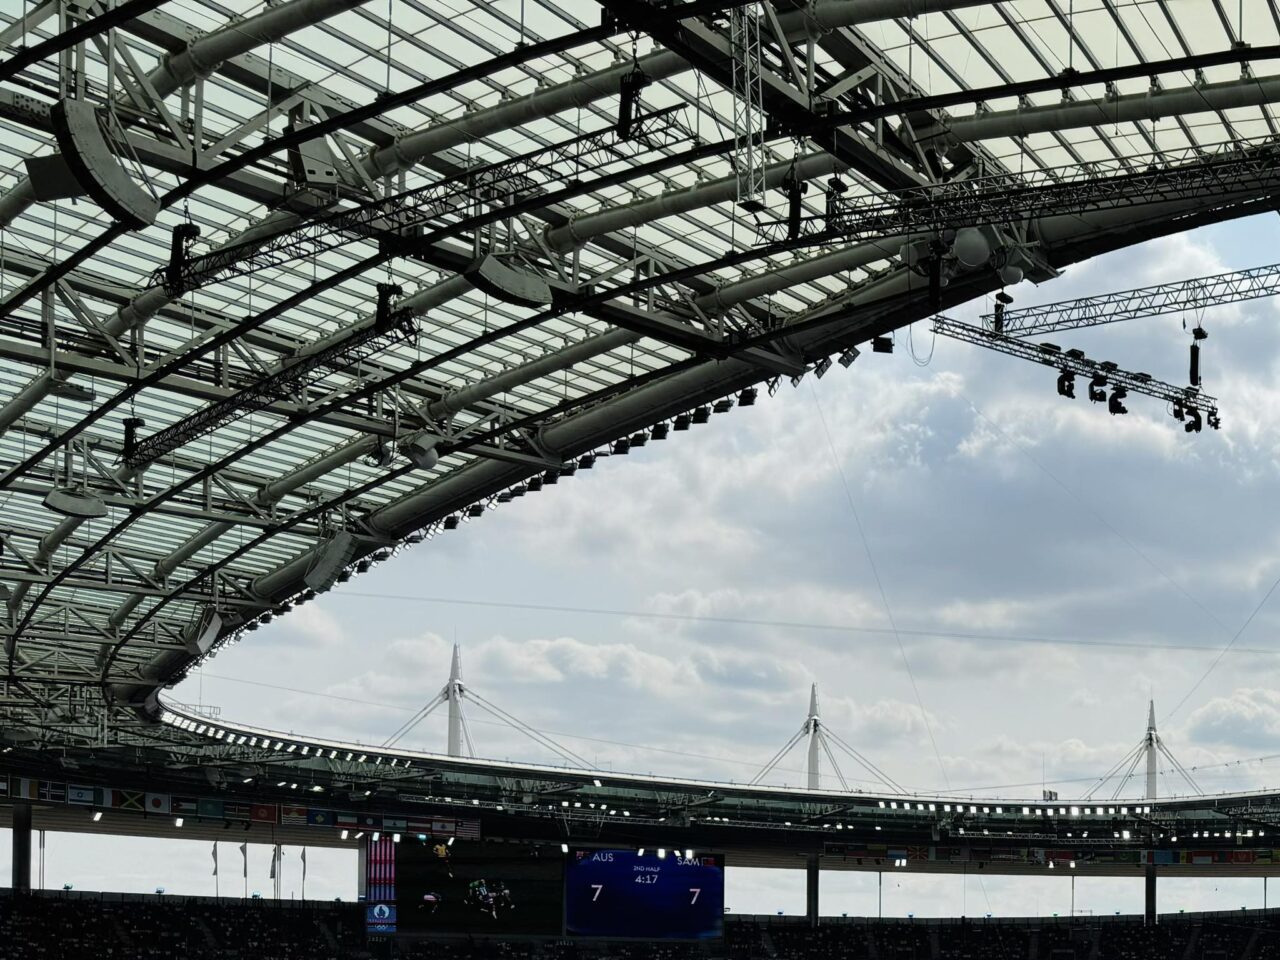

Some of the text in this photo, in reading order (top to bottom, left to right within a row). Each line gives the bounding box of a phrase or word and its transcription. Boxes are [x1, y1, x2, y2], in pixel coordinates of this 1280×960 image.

[593, 853, 614, 862] AUS
[677, 857, 700, 867] SAM
[635, 875, 658, 884] 4:17
[591, 884, 603, 901] 7
[689, 888, 701, 904] 7
